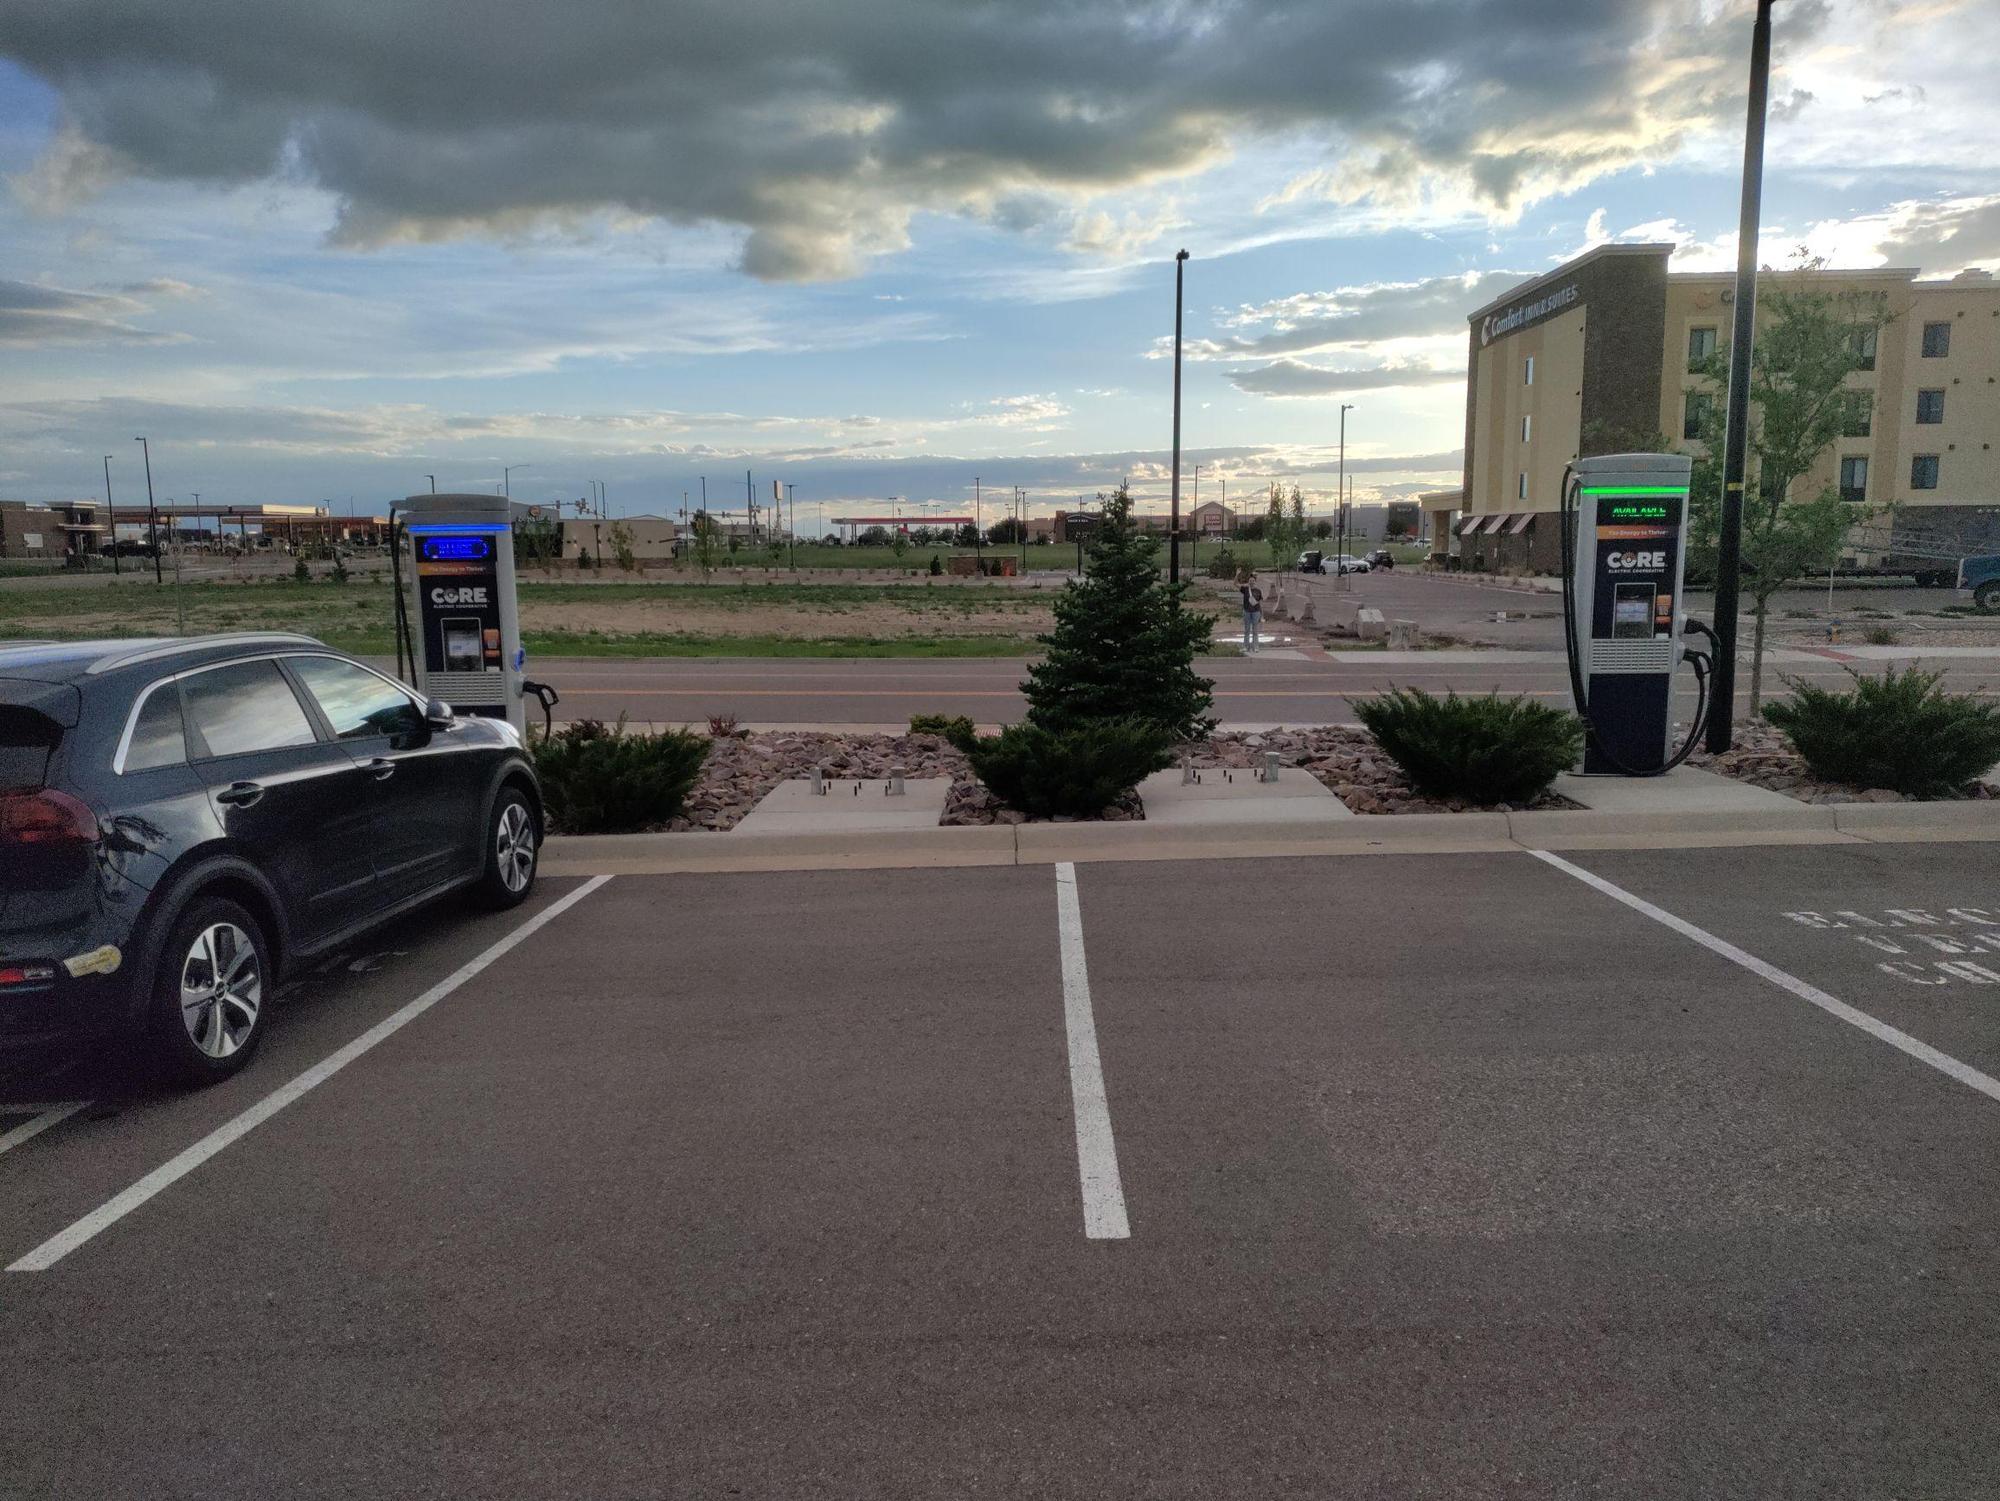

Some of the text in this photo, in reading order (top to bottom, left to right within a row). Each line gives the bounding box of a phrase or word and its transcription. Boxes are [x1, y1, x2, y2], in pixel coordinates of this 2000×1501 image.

[1492, 307, 1523, 337] Comfort
[1607, 551, 1666, 568] CORE
[431, 587, 488, 604] CORE
